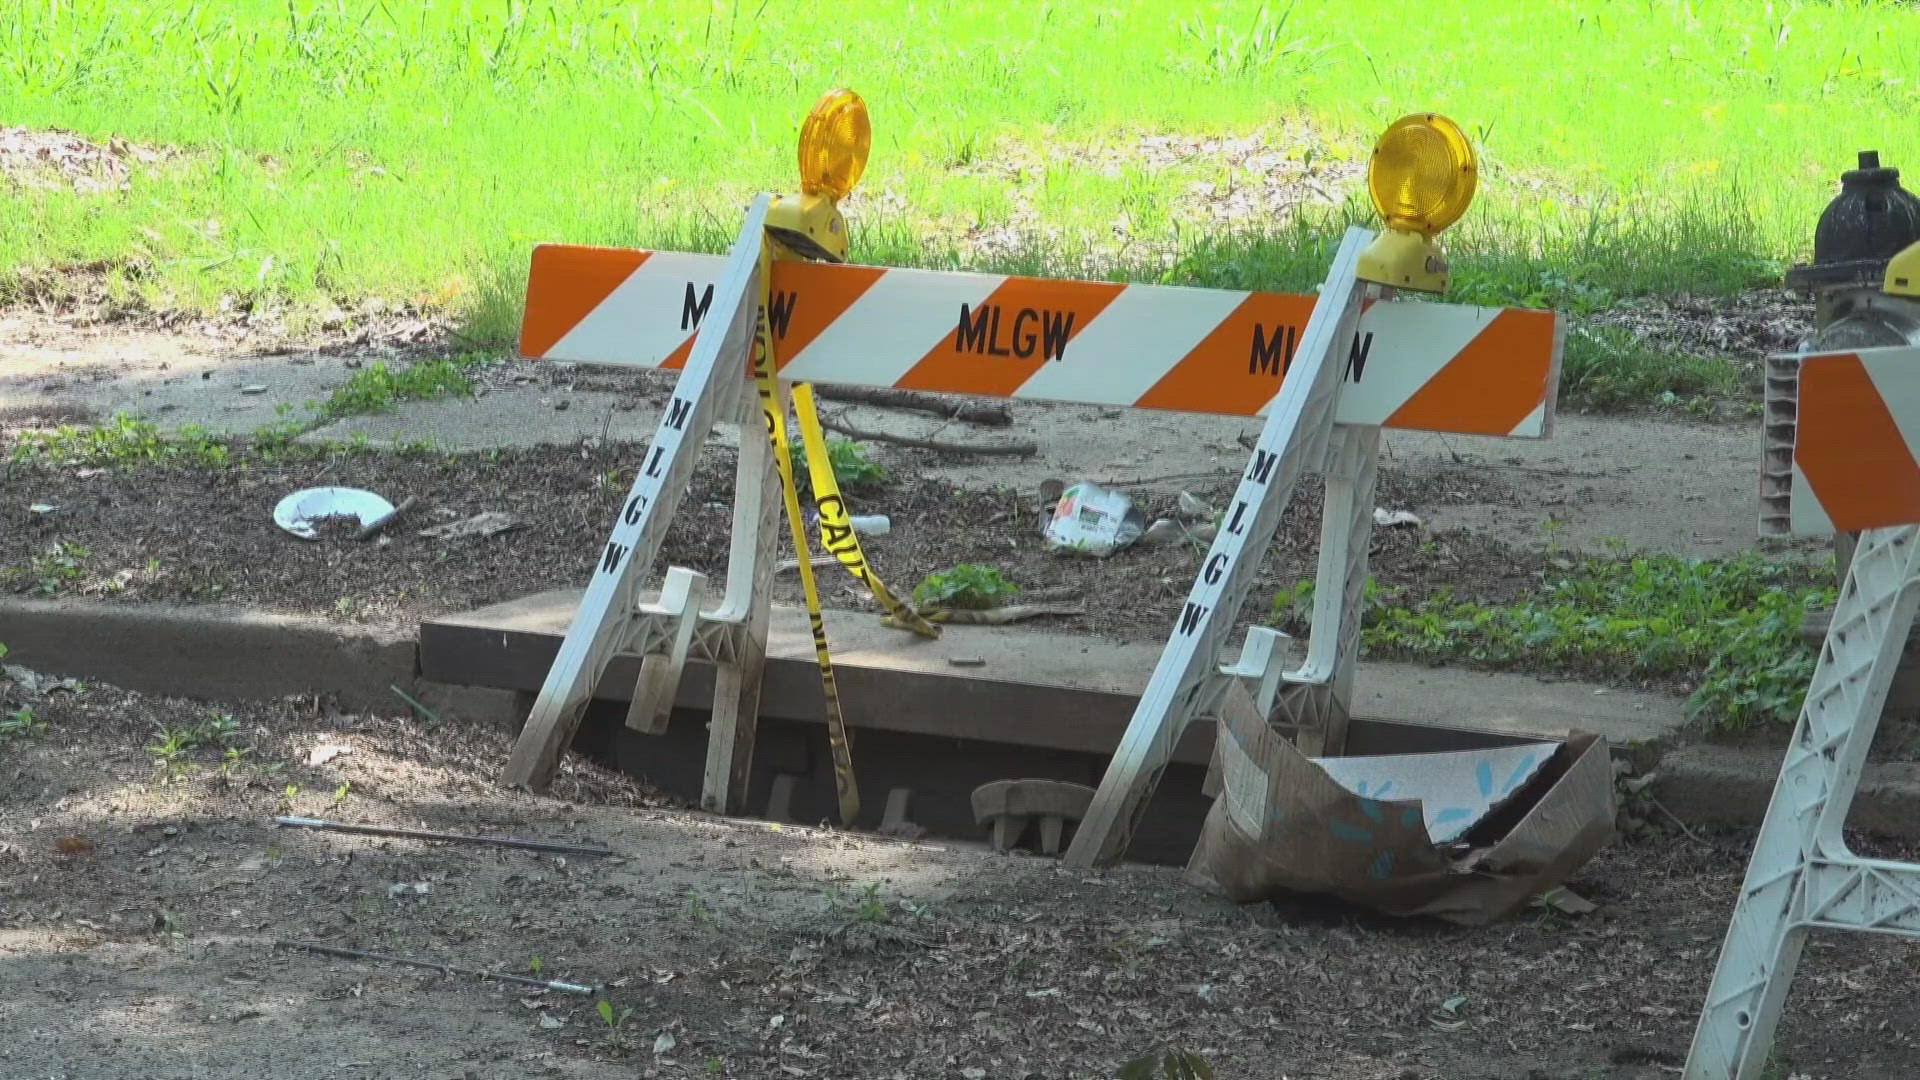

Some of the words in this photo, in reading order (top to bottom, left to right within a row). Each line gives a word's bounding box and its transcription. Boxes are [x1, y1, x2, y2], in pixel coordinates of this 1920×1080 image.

[681, 282, 797, 340] MW
[956, 303, 1075, 362] MLGW
[1249, 323, 1373, 384] MLW
[602, 397, 693, 575] MLGW
[1179, 449, 1277, 637] MLGW
